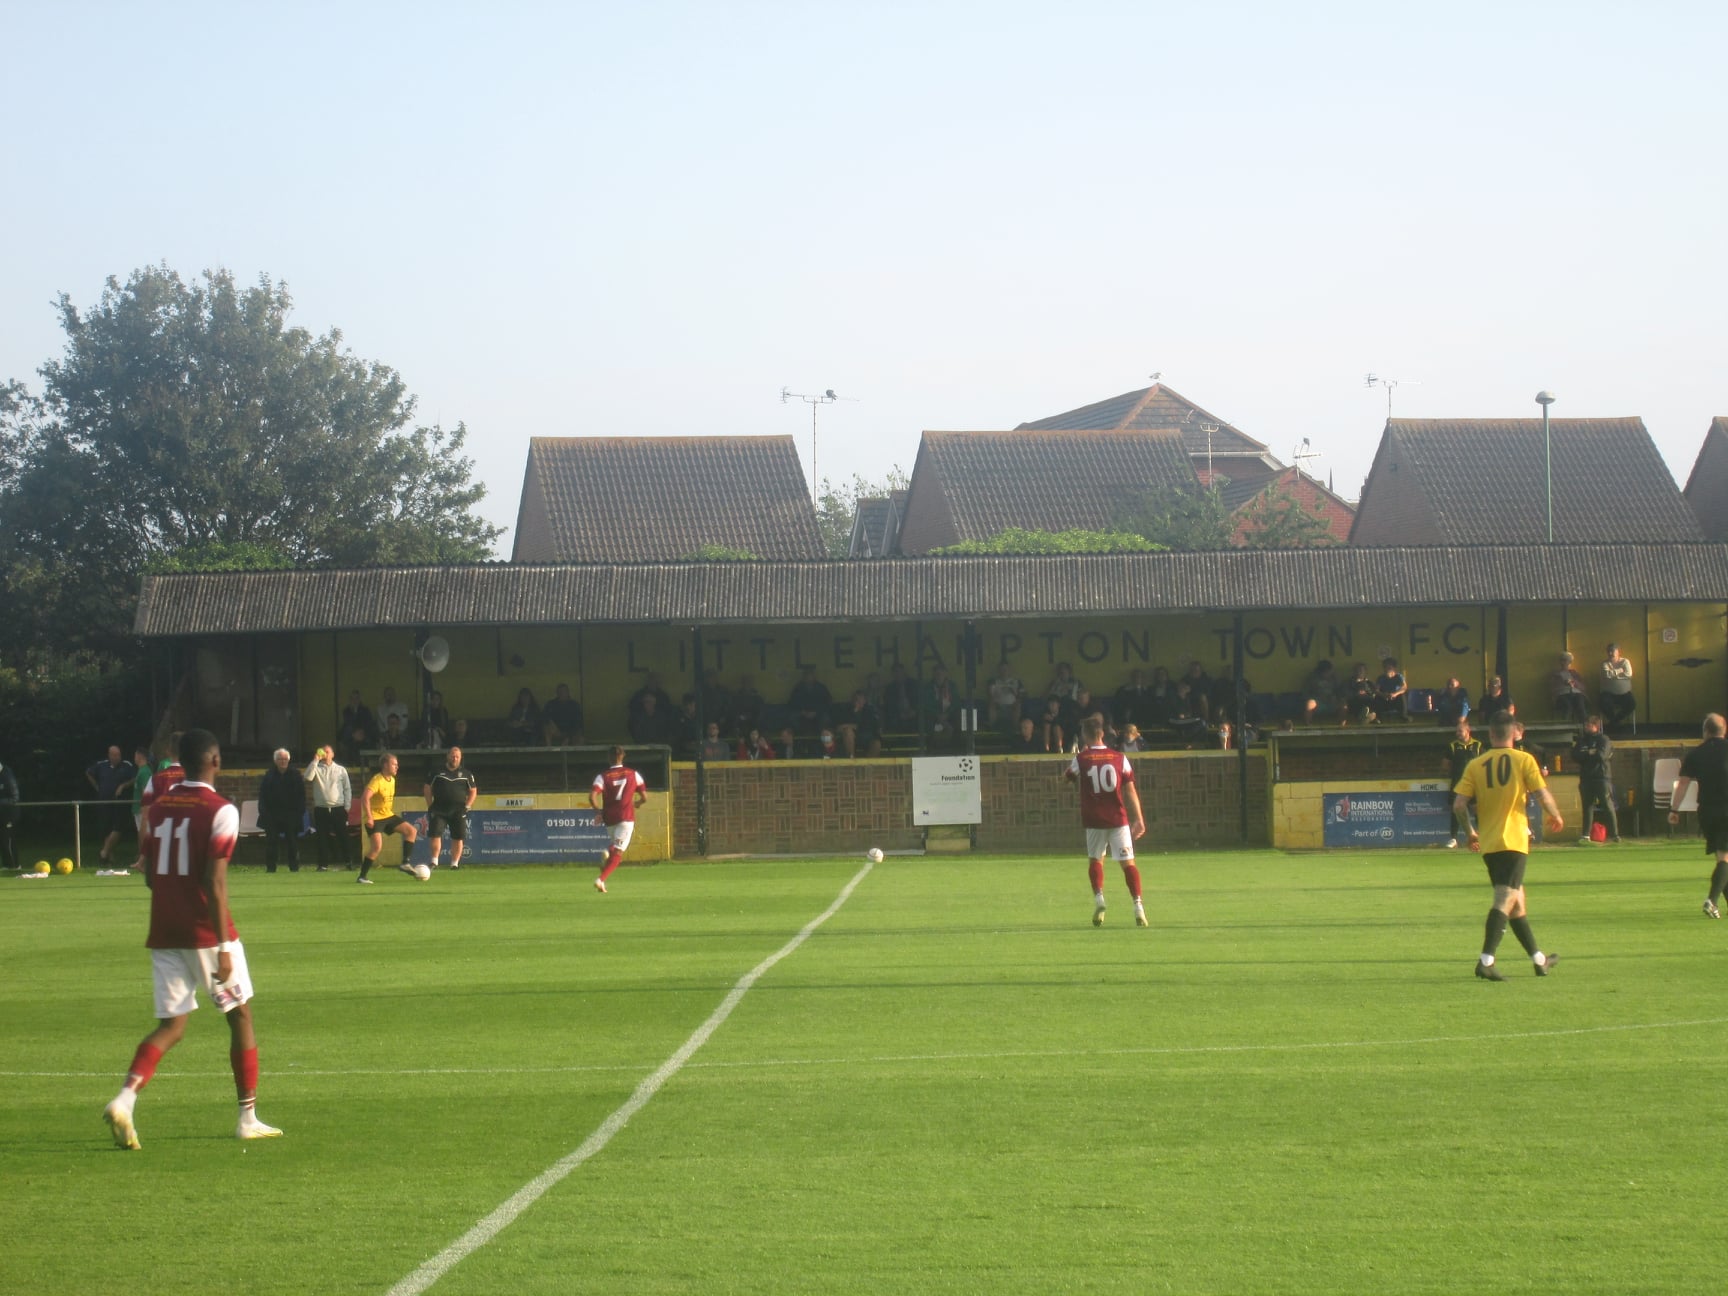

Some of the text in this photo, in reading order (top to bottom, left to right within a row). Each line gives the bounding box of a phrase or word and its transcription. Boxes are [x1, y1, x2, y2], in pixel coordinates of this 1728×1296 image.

[627, 622, 1481, 673] LITTLEHAMPTON TOWN F.C.
[1482, 753, 1512, 789] 10
[941, 774, 976, 782] Foundation
[1087, 764, 1118, 794] 10
[612, 778, 628, 801] 7
[1420, 783, 1439, 791] HOME
[505, 799, 524, 807] AWAY
[1351, 801, 1394, 811] RAINBOW
[546, 818, 576, 827] 01903
[1369, 829, 1379, 837] of
[154, 817, 190, 876] 11
